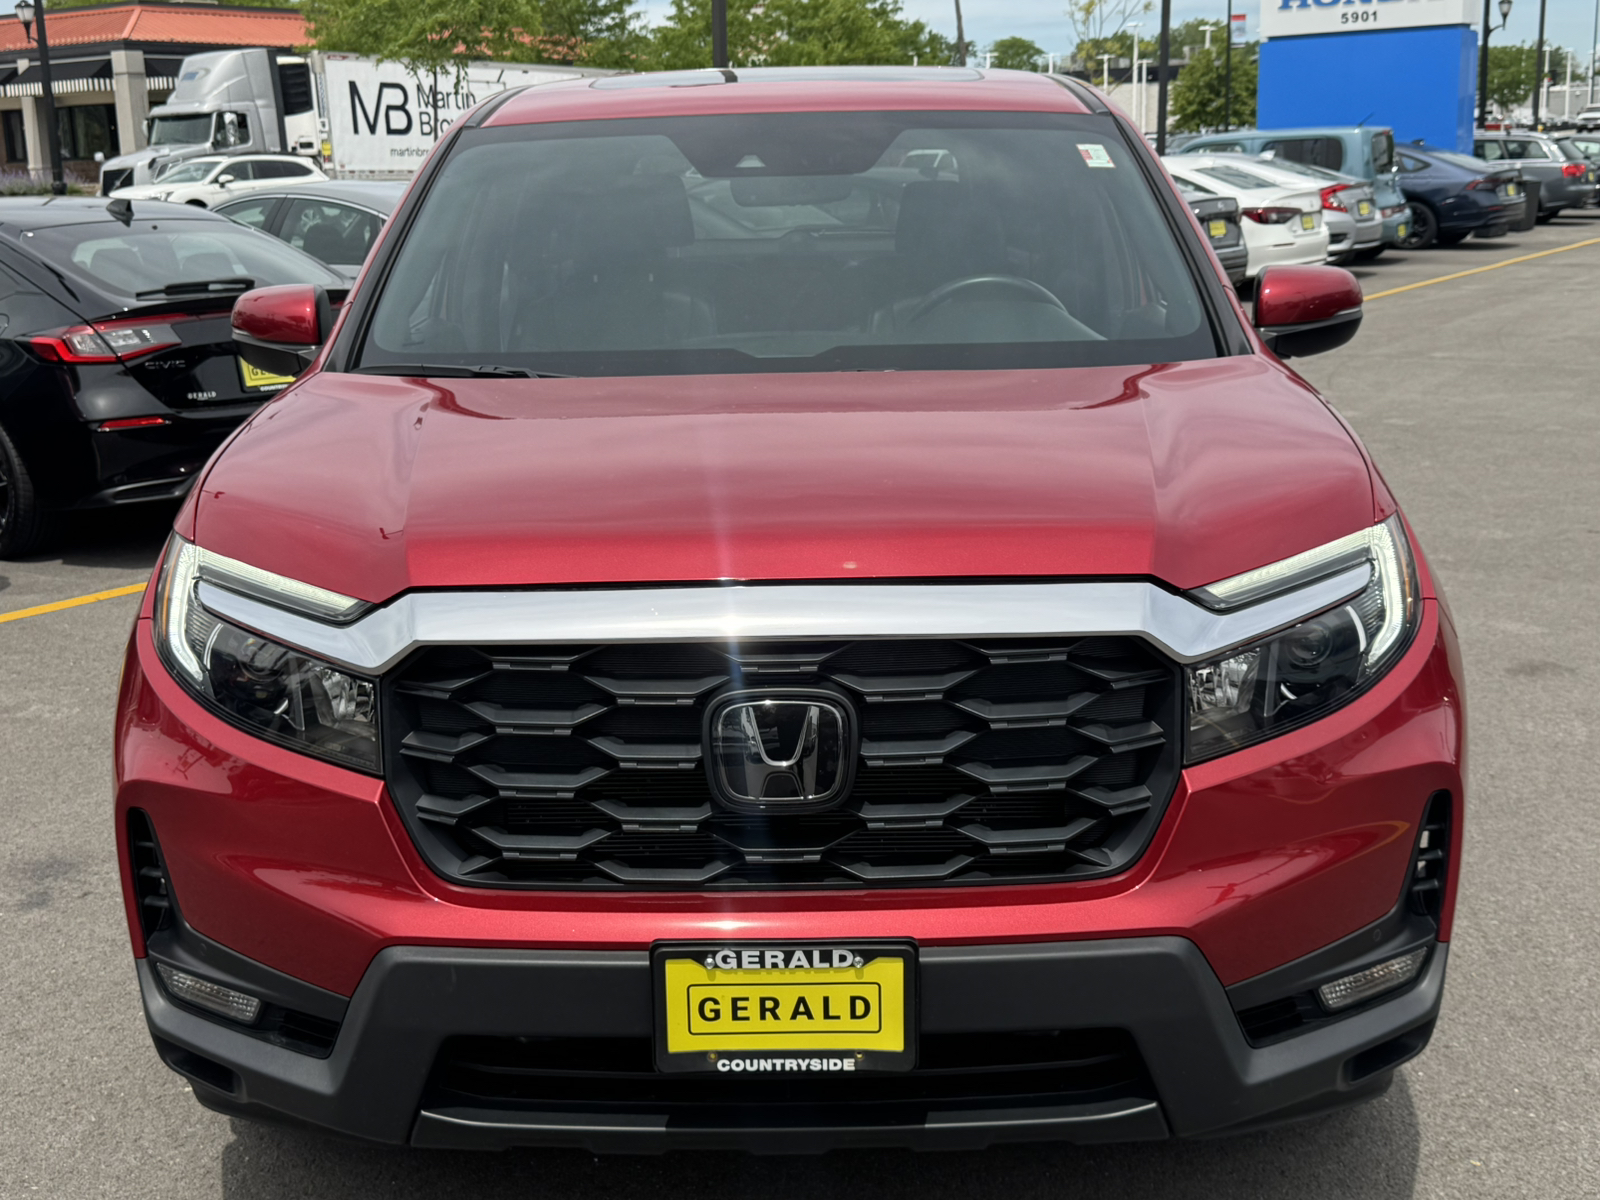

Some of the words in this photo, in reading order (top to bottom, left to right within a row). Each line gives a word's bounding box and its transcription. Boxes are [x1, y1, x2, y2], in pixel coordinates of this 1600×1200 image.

[1340, 10, 1378, 24] 5901
[416, 84, 476, 110] Martin
[348, 80, 413, 136] MB
[390, 147, 430, 157] martinbr
[145, 359, 186, 370] CIVIC
[187, 391, 217, 400] GERALD
[714, 948, 854, 970] GERALD
[697, 995, 872, 1022] GERALD
[716, 1058, 856, 1072] COUNTRYSIDE
